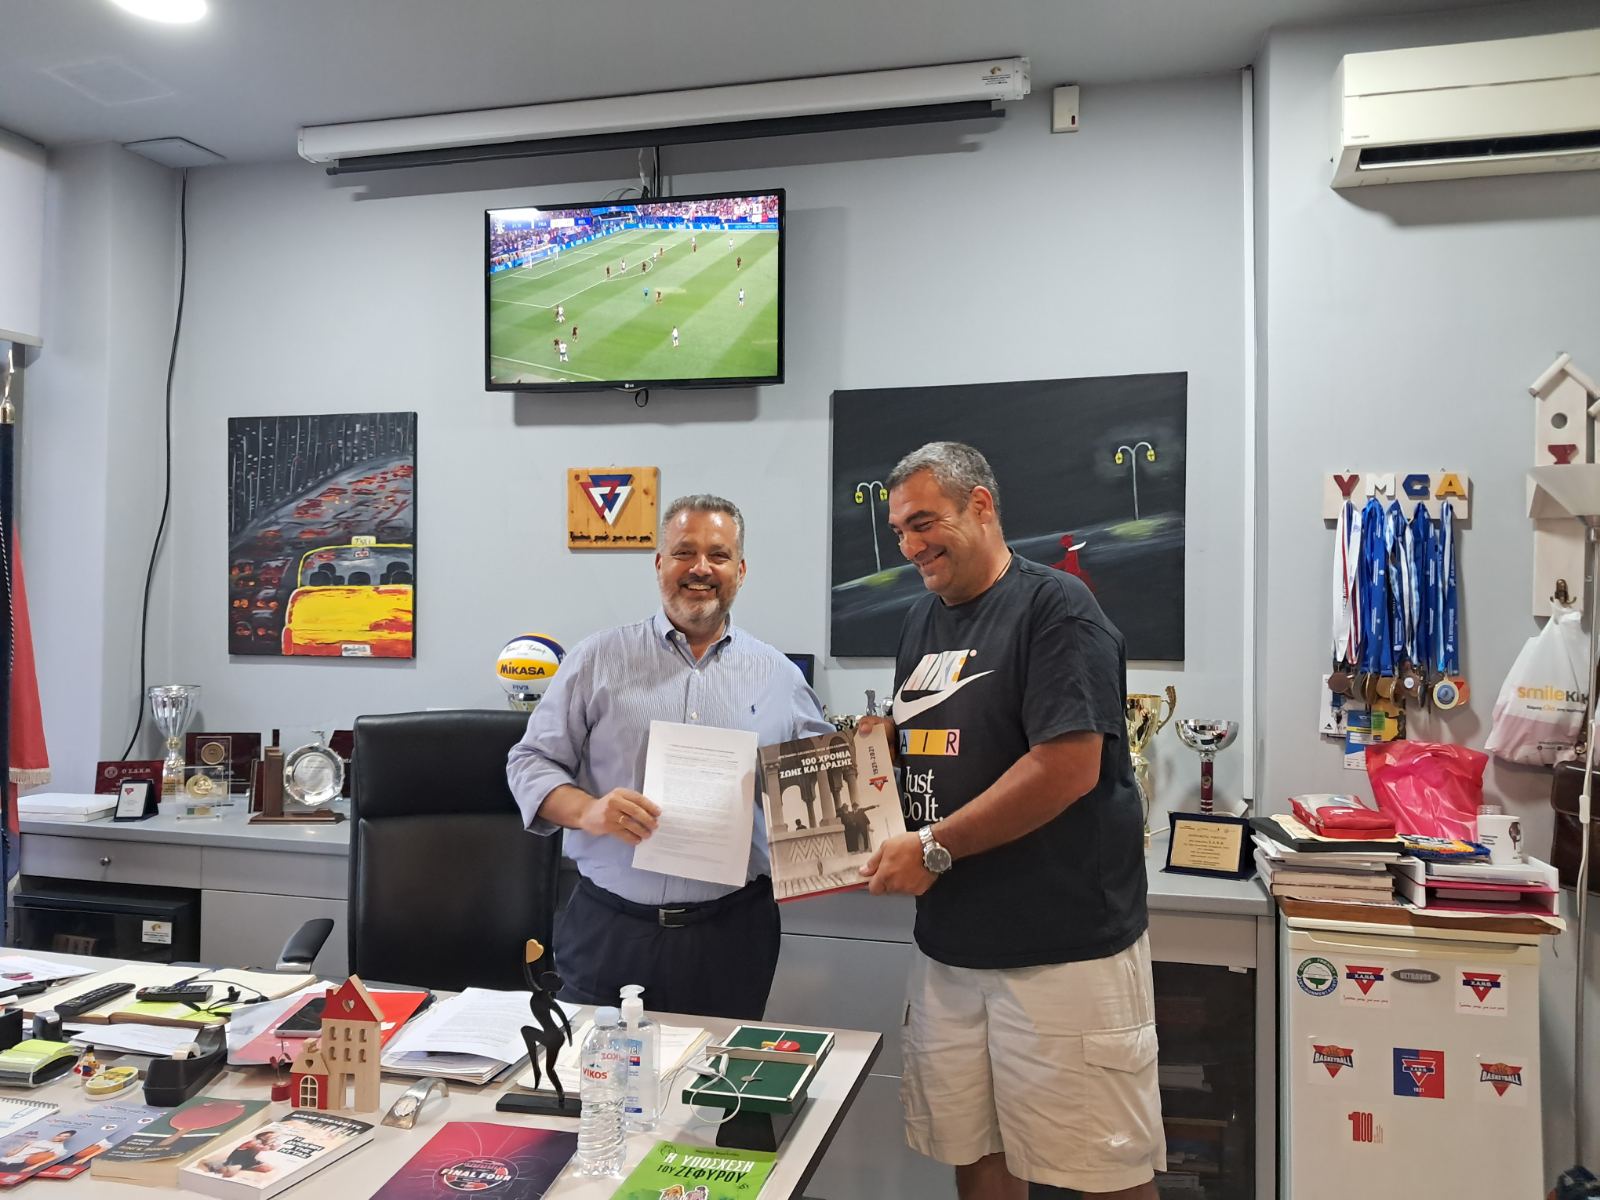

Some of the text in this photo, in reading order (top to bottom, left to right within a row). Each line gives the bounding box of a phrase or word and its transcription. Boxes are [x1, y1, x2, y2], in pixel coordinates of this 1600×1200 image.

[900, 731, 959, 754] AIR
[801, 757, 817, 766] 100
[818, 750, 851, 763] ΧΡΟΝΙΑ
[779, 758, 852, 779] ΖΩΗΣ ΚΑΙ ΔΡΑΣΗΣ
[1314, 1052, 1352, 1066] BASKETBALL
[583, 1067, 608, 1080] VIKOS
[1481, 1069, 1521, 1083] BASKETBALL
[664, 1152, 755, 1173] Η ΥΠΟΣΧΕΣΗ
[440, 1168, 512, 1182] FINAL FOUR
[657, 1165, 748, 1183] ΤΟΥ ΖΕΦΥΡΟΥ
